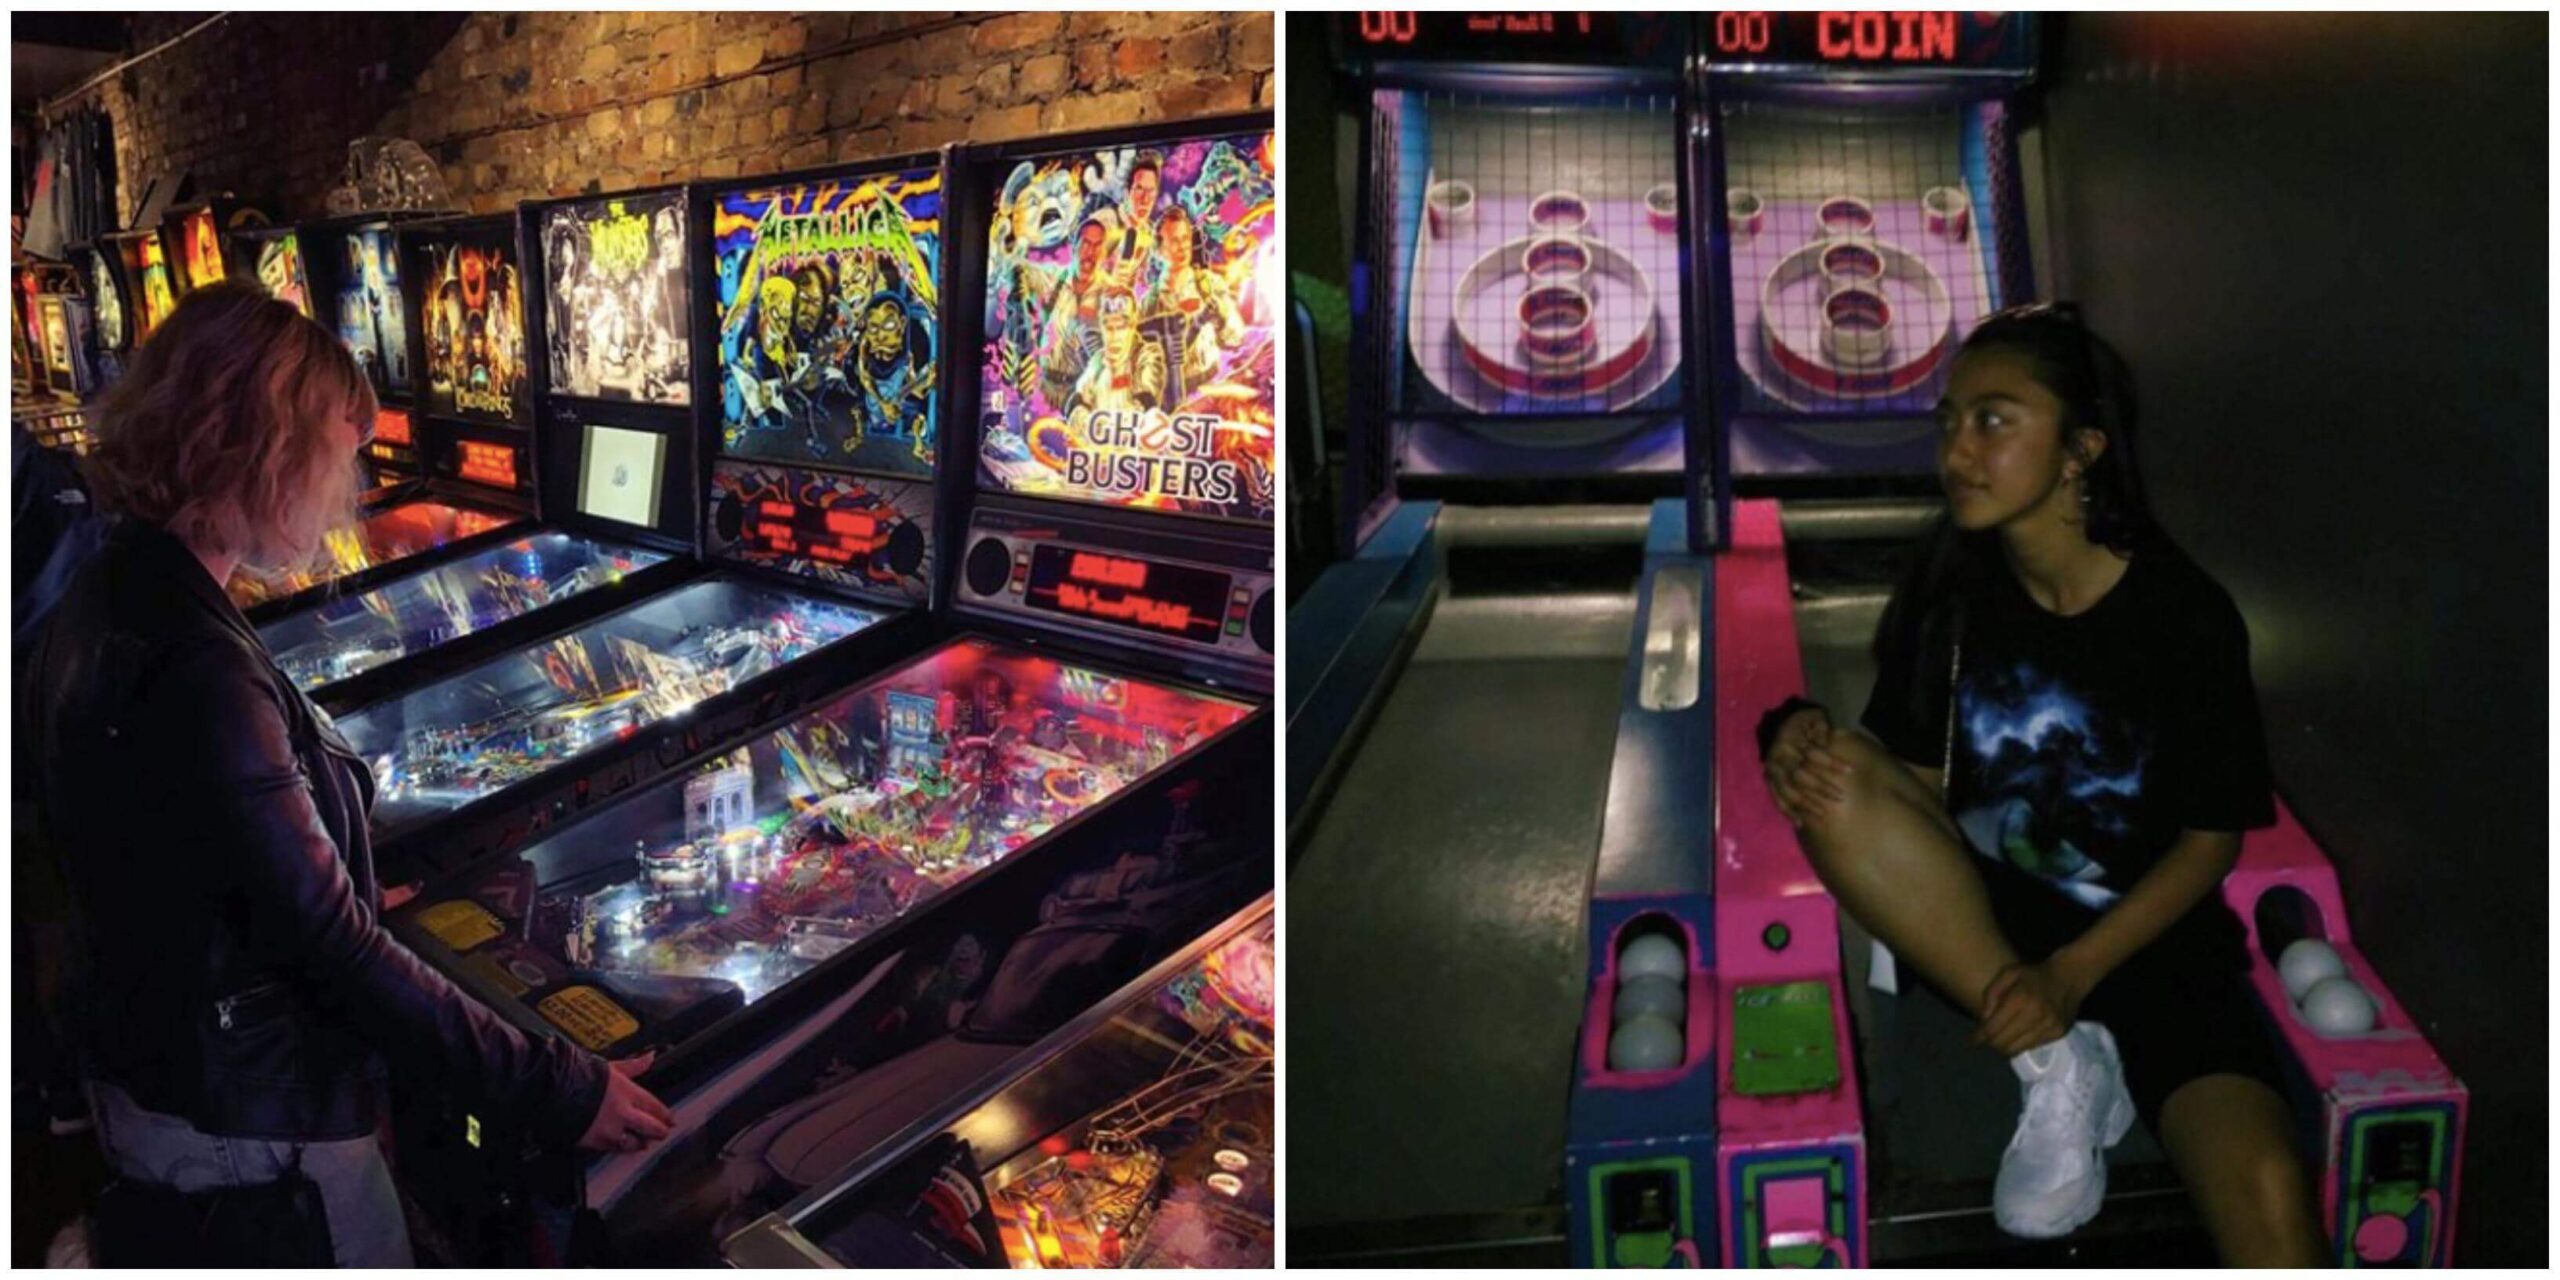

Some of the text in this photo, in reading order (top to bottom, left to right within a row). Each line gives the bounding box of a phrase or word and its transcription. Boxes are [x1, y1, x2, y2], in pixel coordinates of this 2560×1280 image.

[1716, 11, 1955, 59] 00 COIN
[1067, 451, 1235, 501] BUSTERS
